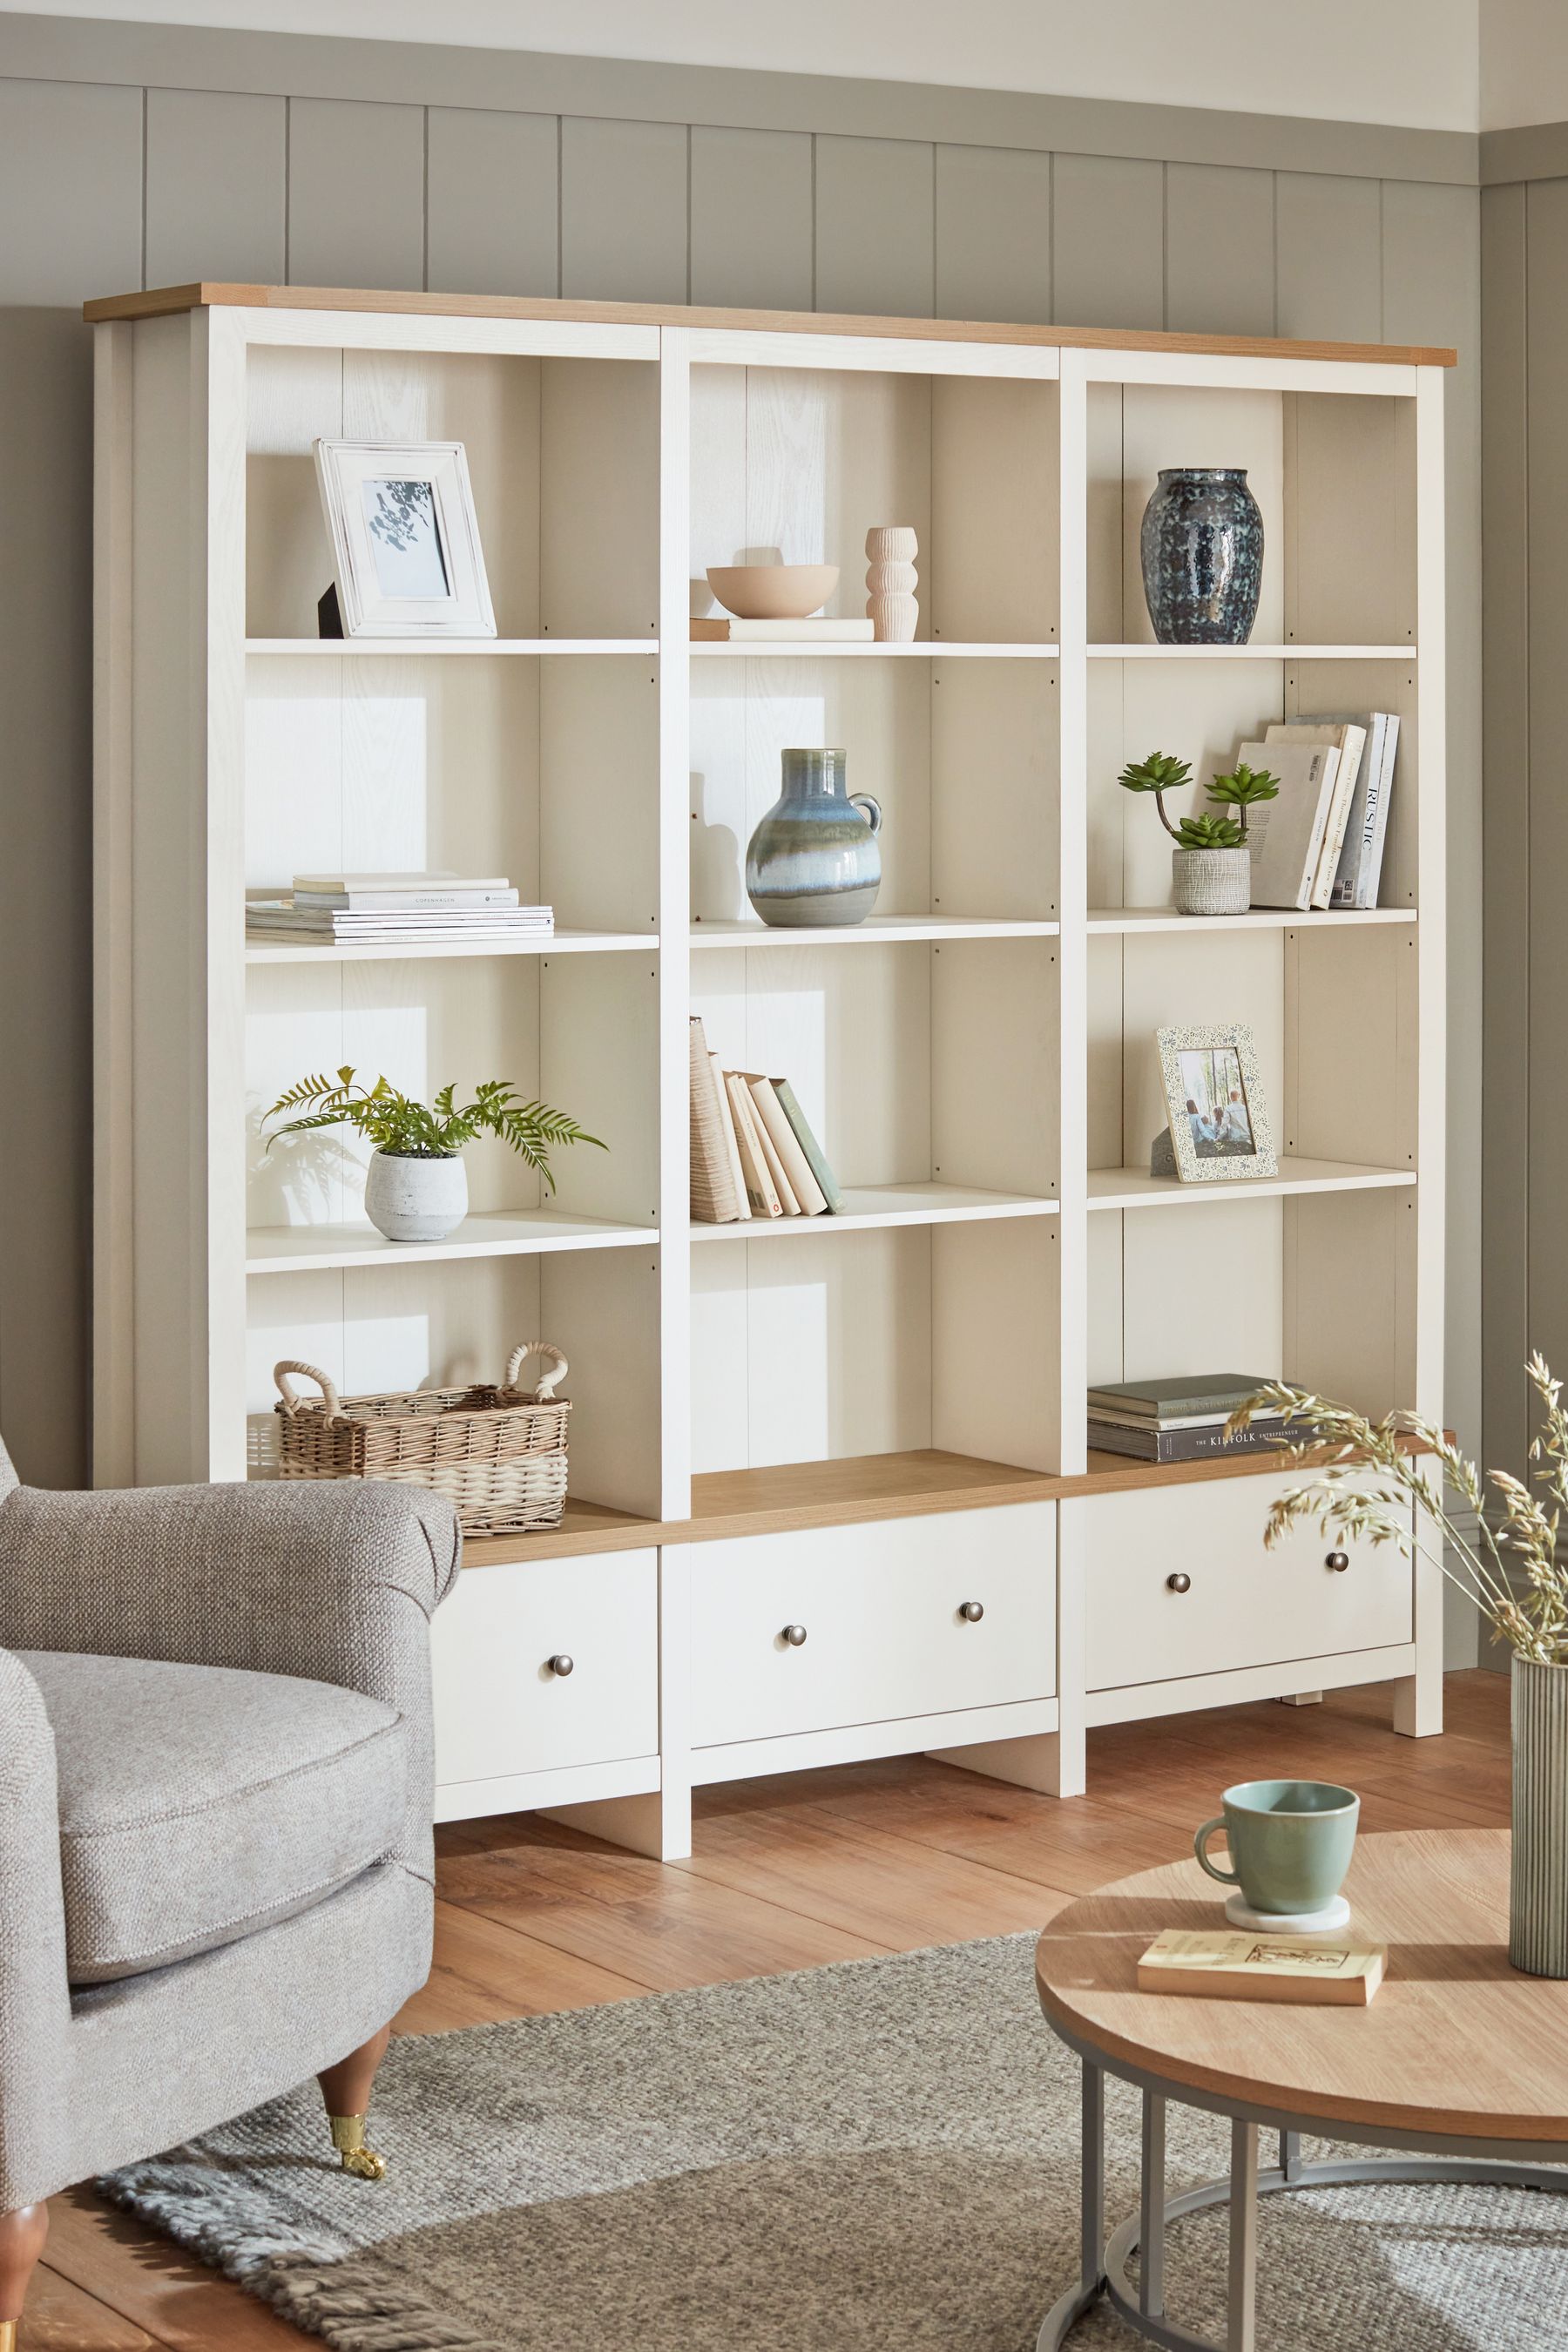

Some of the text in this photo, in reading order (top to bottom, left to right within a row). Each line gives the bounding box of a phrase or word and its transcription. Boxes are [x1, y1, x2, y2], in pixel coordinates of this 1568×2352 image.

[1336, 799, 1347, 828] Through
[1362, 787, 1378, 851] RUSTIC
[1259, 1429, 1299, 1439] ENTREPRENEUR
